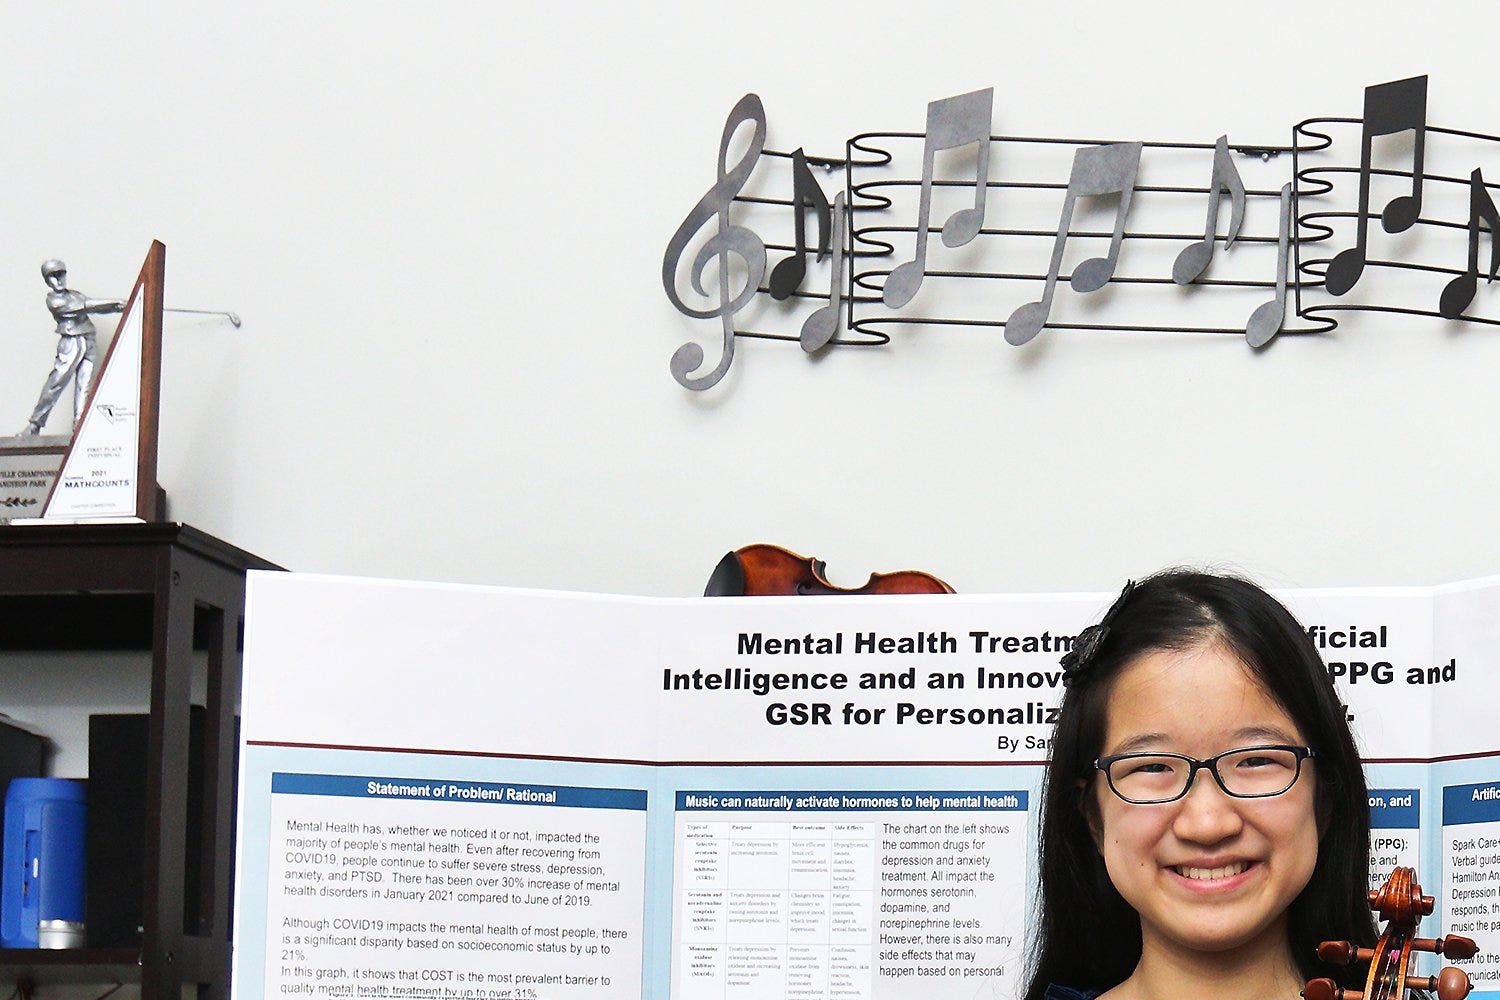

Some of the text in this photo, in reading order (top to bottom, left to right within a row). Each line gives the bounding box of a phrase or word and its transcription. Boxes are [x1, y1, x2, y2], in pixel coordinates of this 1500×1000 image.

[64, 480, 130, 488] MATHCOUNTS
[738, 626, 1387, 654] Mental Health Treatm ficial
[663, 658, 1456, 695] Intelligence and an Innov PPG and
[766, 702, 1060, 725] GSR for Personaliz
[998, 736, 1053, 752] By Sar
[367, 781, 556, 802] Statement of Problem/ Rational
[686, 795, 1017, 810] Music can naturally activate hormones to help mental health
[1368, 795, 1412, 808] on, and
[287, 820, 599, 844] Mental Health has, whether we noticed it or not, impacted the
[883, 823, 1009, 834] The chart on the left shows
[1374, 838, 1407, 851] (PPG):
[1452, 839, 1475, 852] Spark
